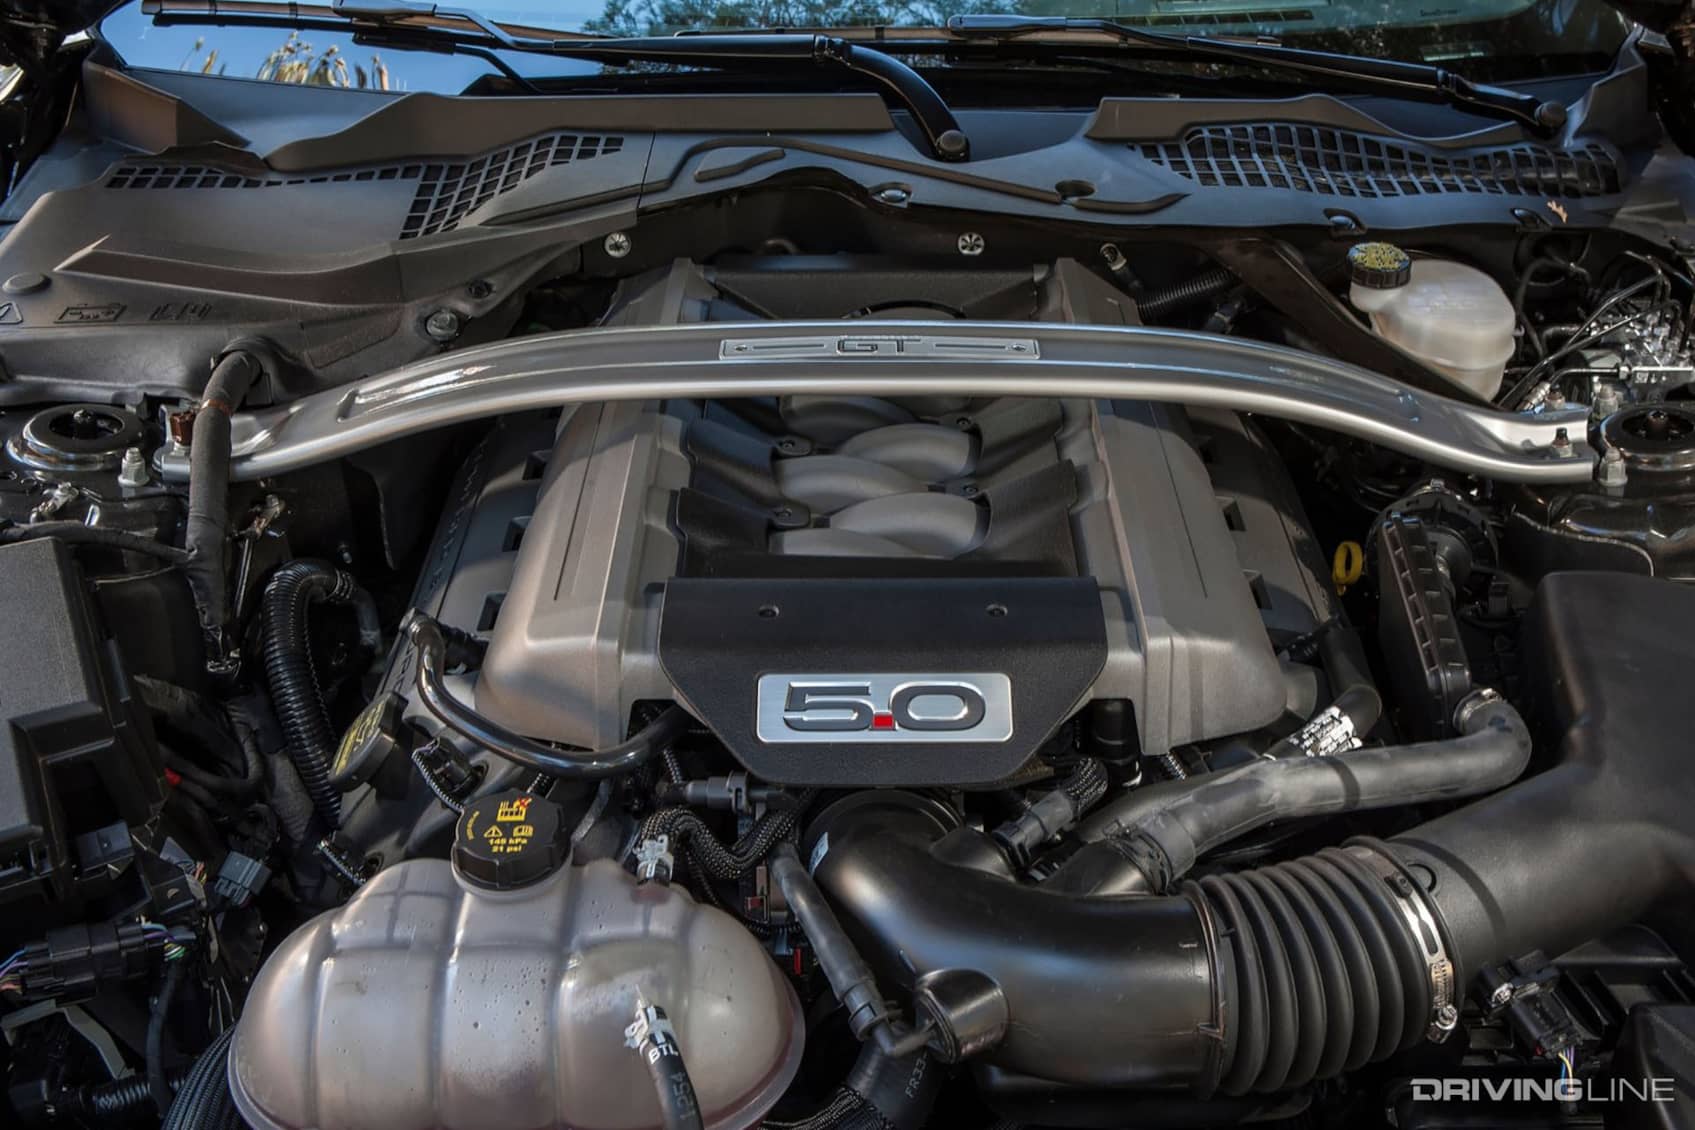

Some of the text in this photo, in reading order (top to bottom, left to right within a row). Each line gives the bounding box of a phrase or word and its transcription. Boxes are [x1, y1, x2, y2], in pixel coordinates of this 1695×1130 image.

[836, 334, 921, 356] GT
[783, 680, 987, 732] 5.0
[648, 1042, 679, 1065] BTL
